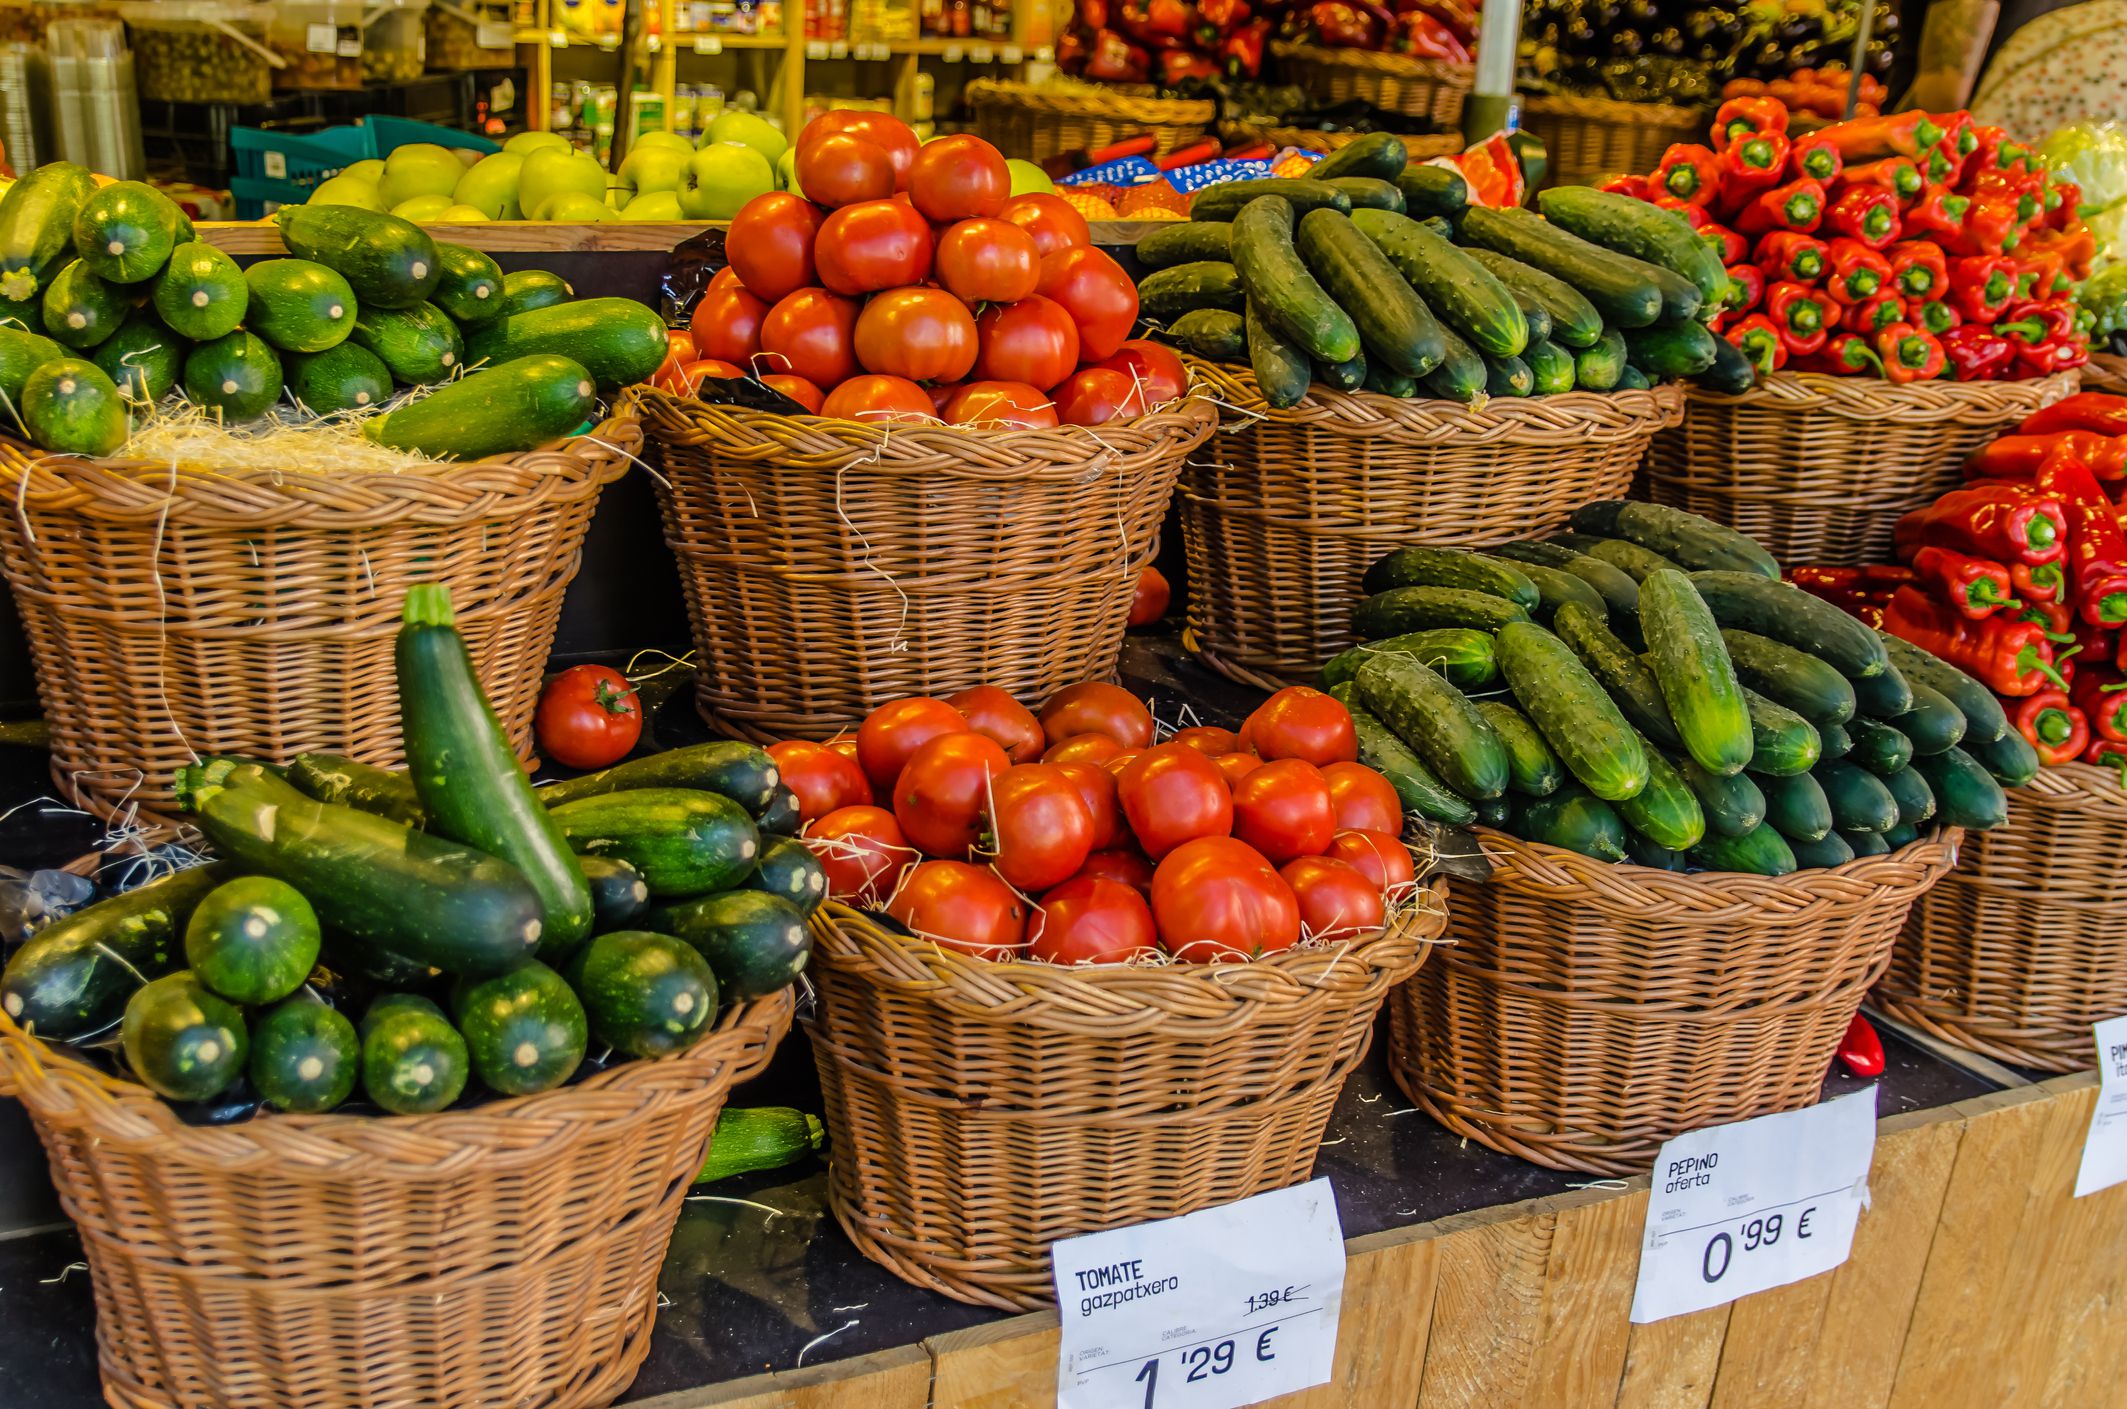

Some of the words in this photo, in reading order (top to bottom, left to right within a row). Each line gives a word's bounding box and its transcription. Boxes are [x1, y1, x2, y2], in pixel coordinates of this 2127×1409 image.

[1668, 1153, 1718, 1178] PEPINO
[1665, 1172, 1710, 1194] oferta
[1797, 1207, 1817, 1239] €
[1075, 1259, 1144, 1291] TOMATE
[1081, 1276, 1178, 1317] gazpatxero
[1256, 1326, 1279, 1361] €
